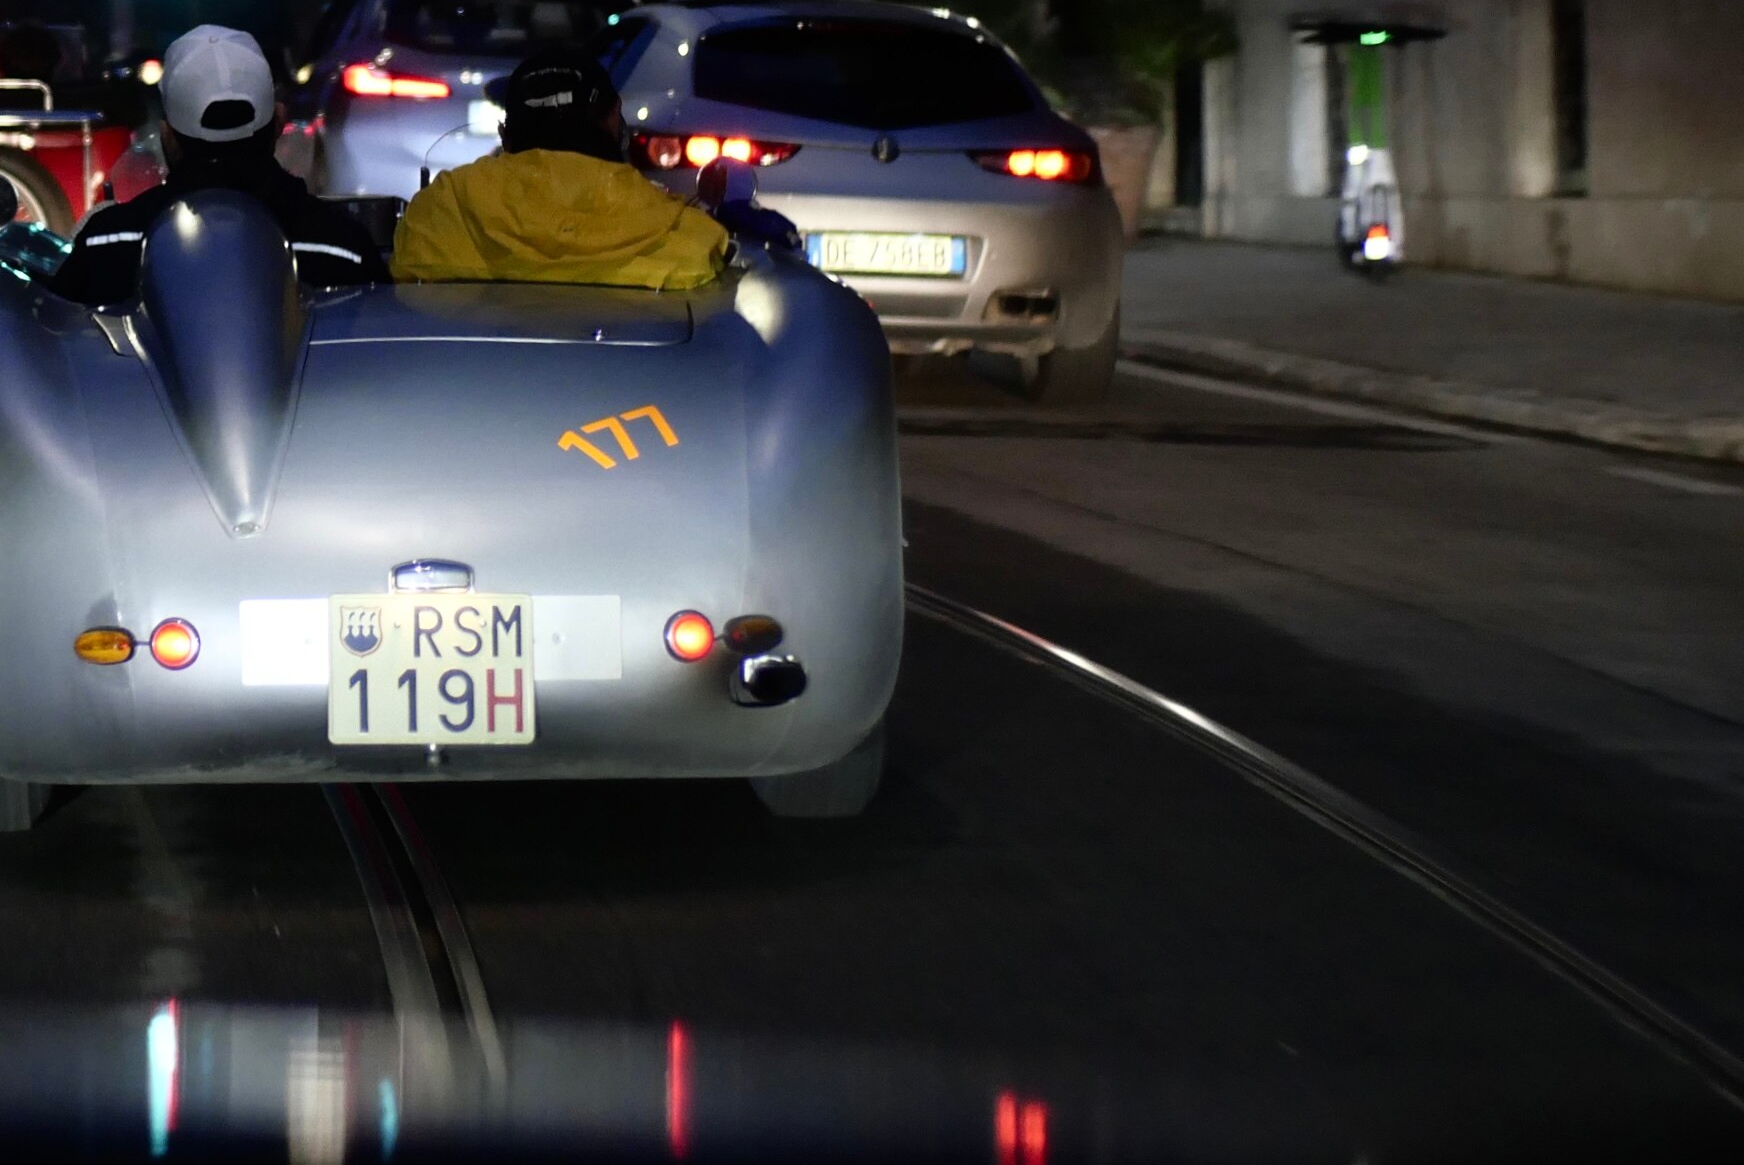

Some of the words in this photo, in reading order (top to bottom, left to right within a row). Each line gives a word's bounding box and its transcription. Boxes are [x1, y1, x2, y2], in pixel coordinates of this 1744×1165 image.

[557, 405, 679, 469] 177
[413, 605, 522, 657] RSM
[349, 669, 523, 732] 119H
